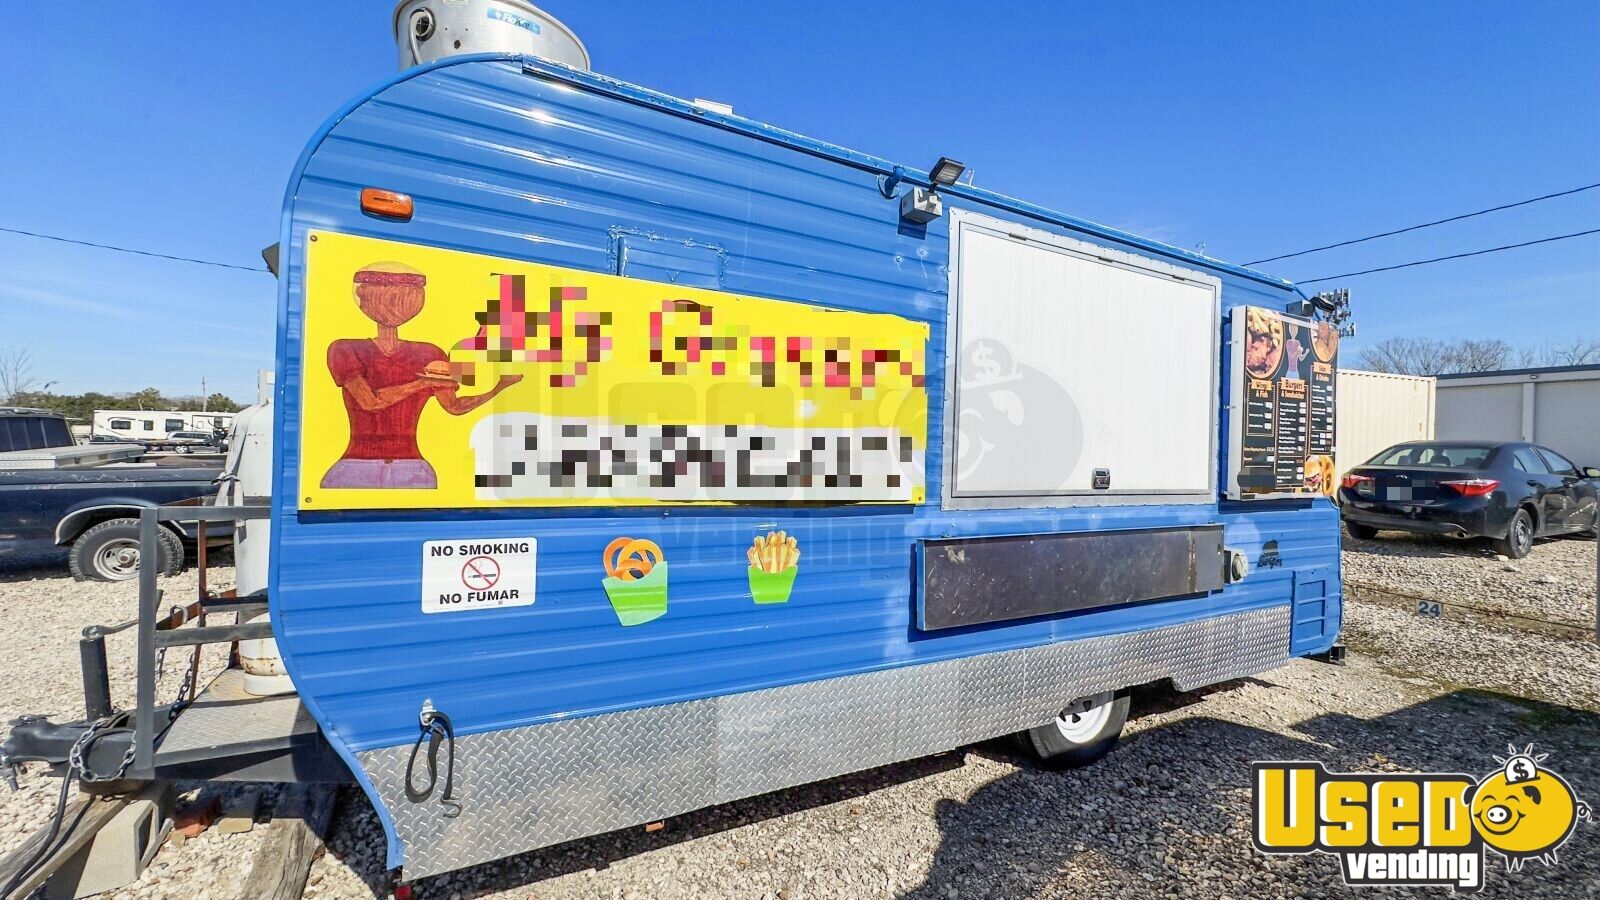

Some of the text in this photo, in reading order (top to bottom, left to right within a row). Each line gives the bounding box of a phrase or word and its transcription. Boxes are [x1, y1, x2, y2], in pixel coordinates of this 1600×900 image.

[1285, 379, 1303, 391] Burgers
[431, 542, 529, 557] NO SMOKING
[439, 589, 519, 605] NO FUMAR
[1418, 600, 1441, 618] 24
